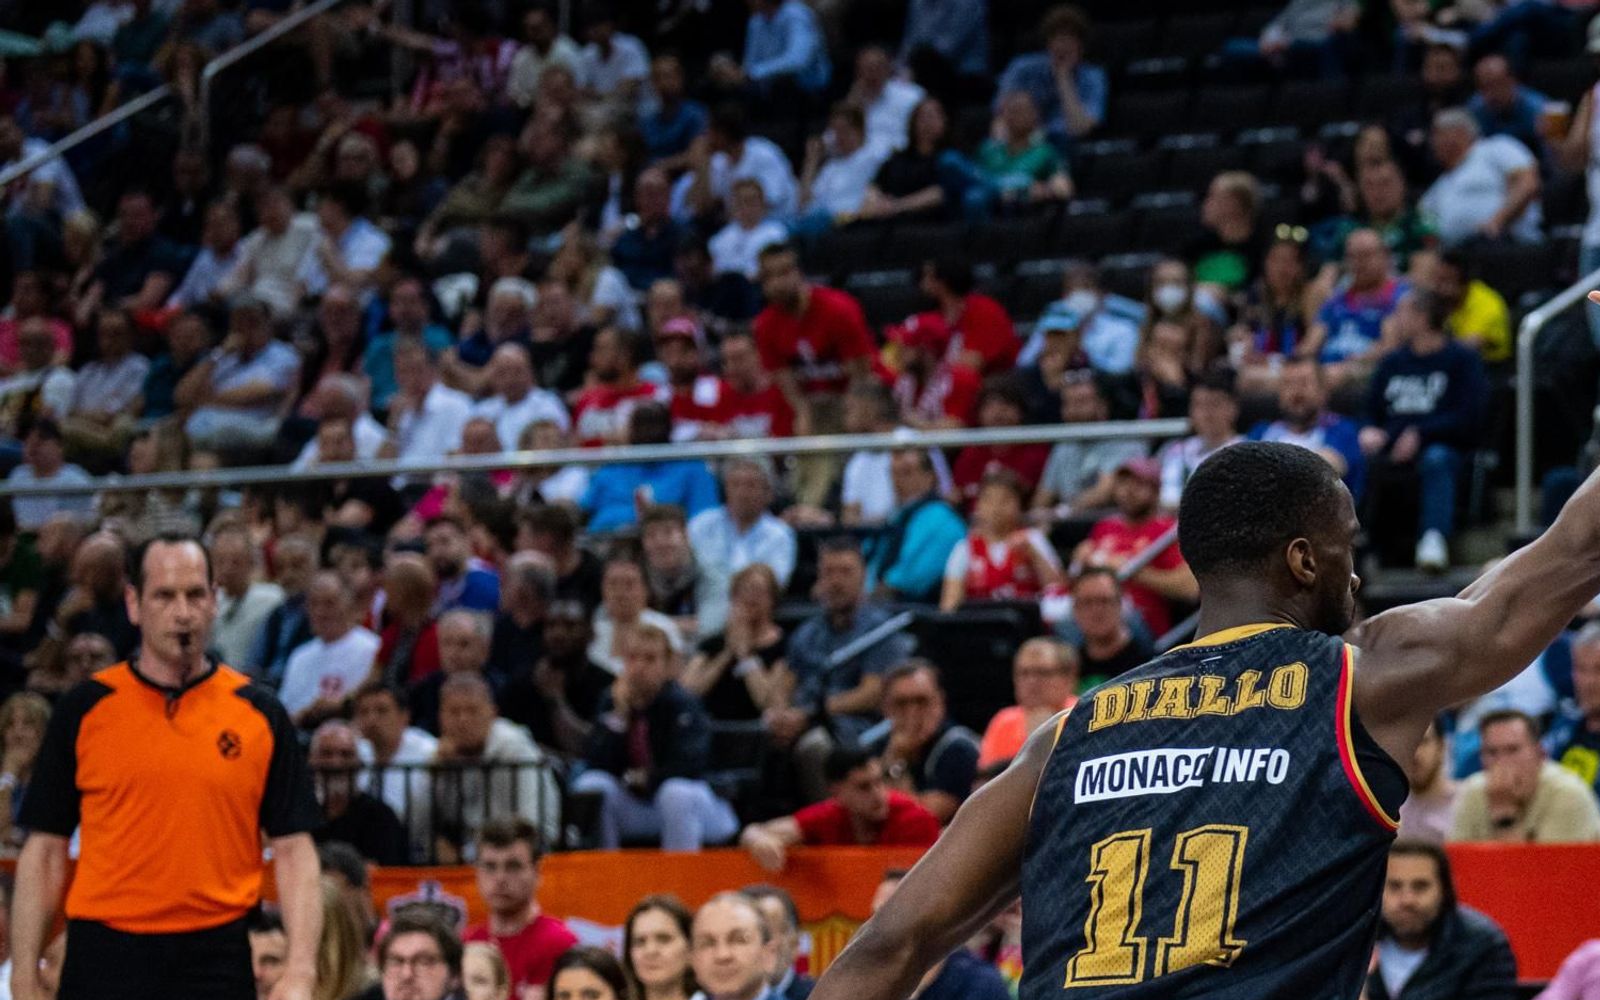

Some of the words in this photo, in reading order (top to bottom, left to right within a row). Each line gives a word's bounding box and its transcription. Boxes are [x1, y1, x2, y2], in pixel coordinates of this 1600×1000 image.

[1088, 661, 1309, 733] DIALLO
[1211, 747, 1290, 785] INFO
[1063, 824, 1249, 989] 11
